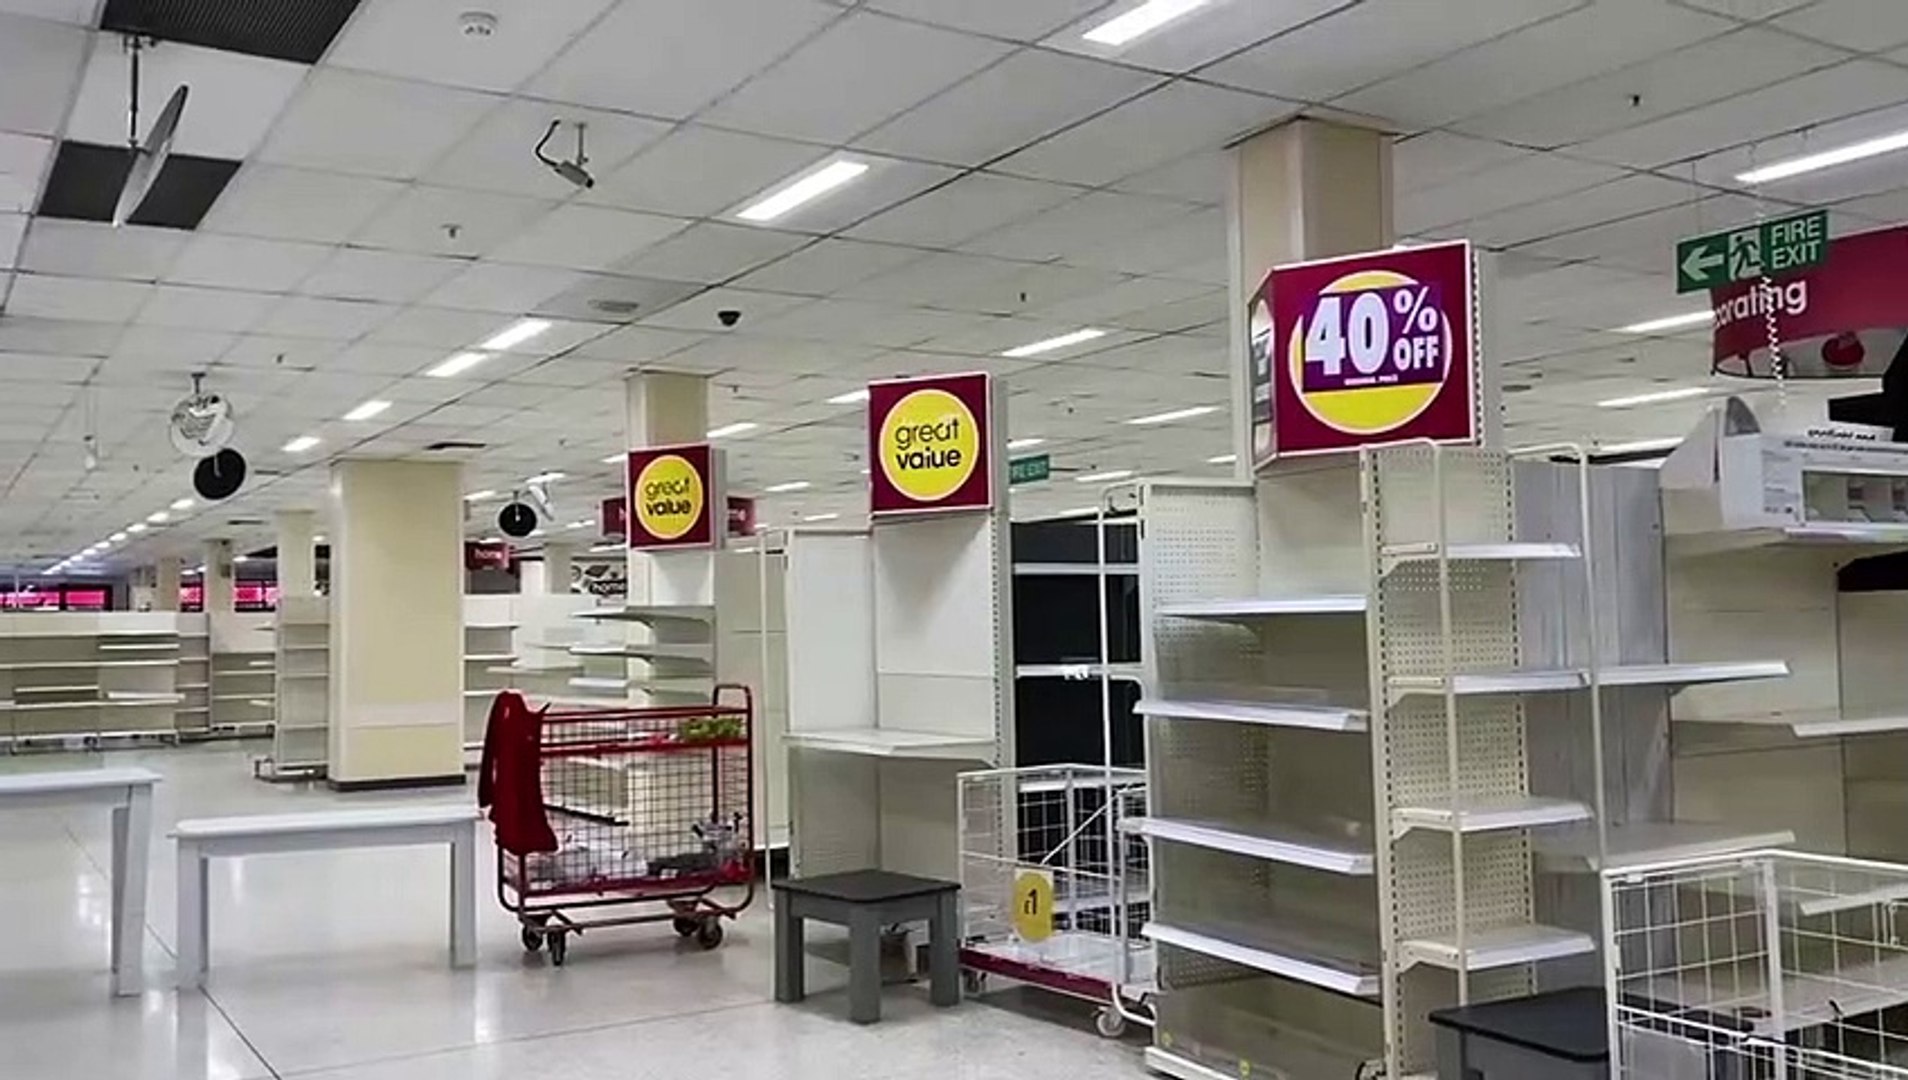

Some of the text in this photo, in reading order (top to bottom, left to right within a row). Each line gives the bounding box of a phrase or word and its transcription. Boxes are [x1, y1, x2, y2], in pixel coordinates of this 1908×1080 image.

[1771, 216, 1821, 246] FIRE
[1772, 240, 1822, 270] EXIT
[1393, 335, 1439, 371] OFF
[895, 418, 959, 451] great
[896, 447, 961, 470] value
[645, 477, 690, 501] great
[645, 499, 692, 516] value
